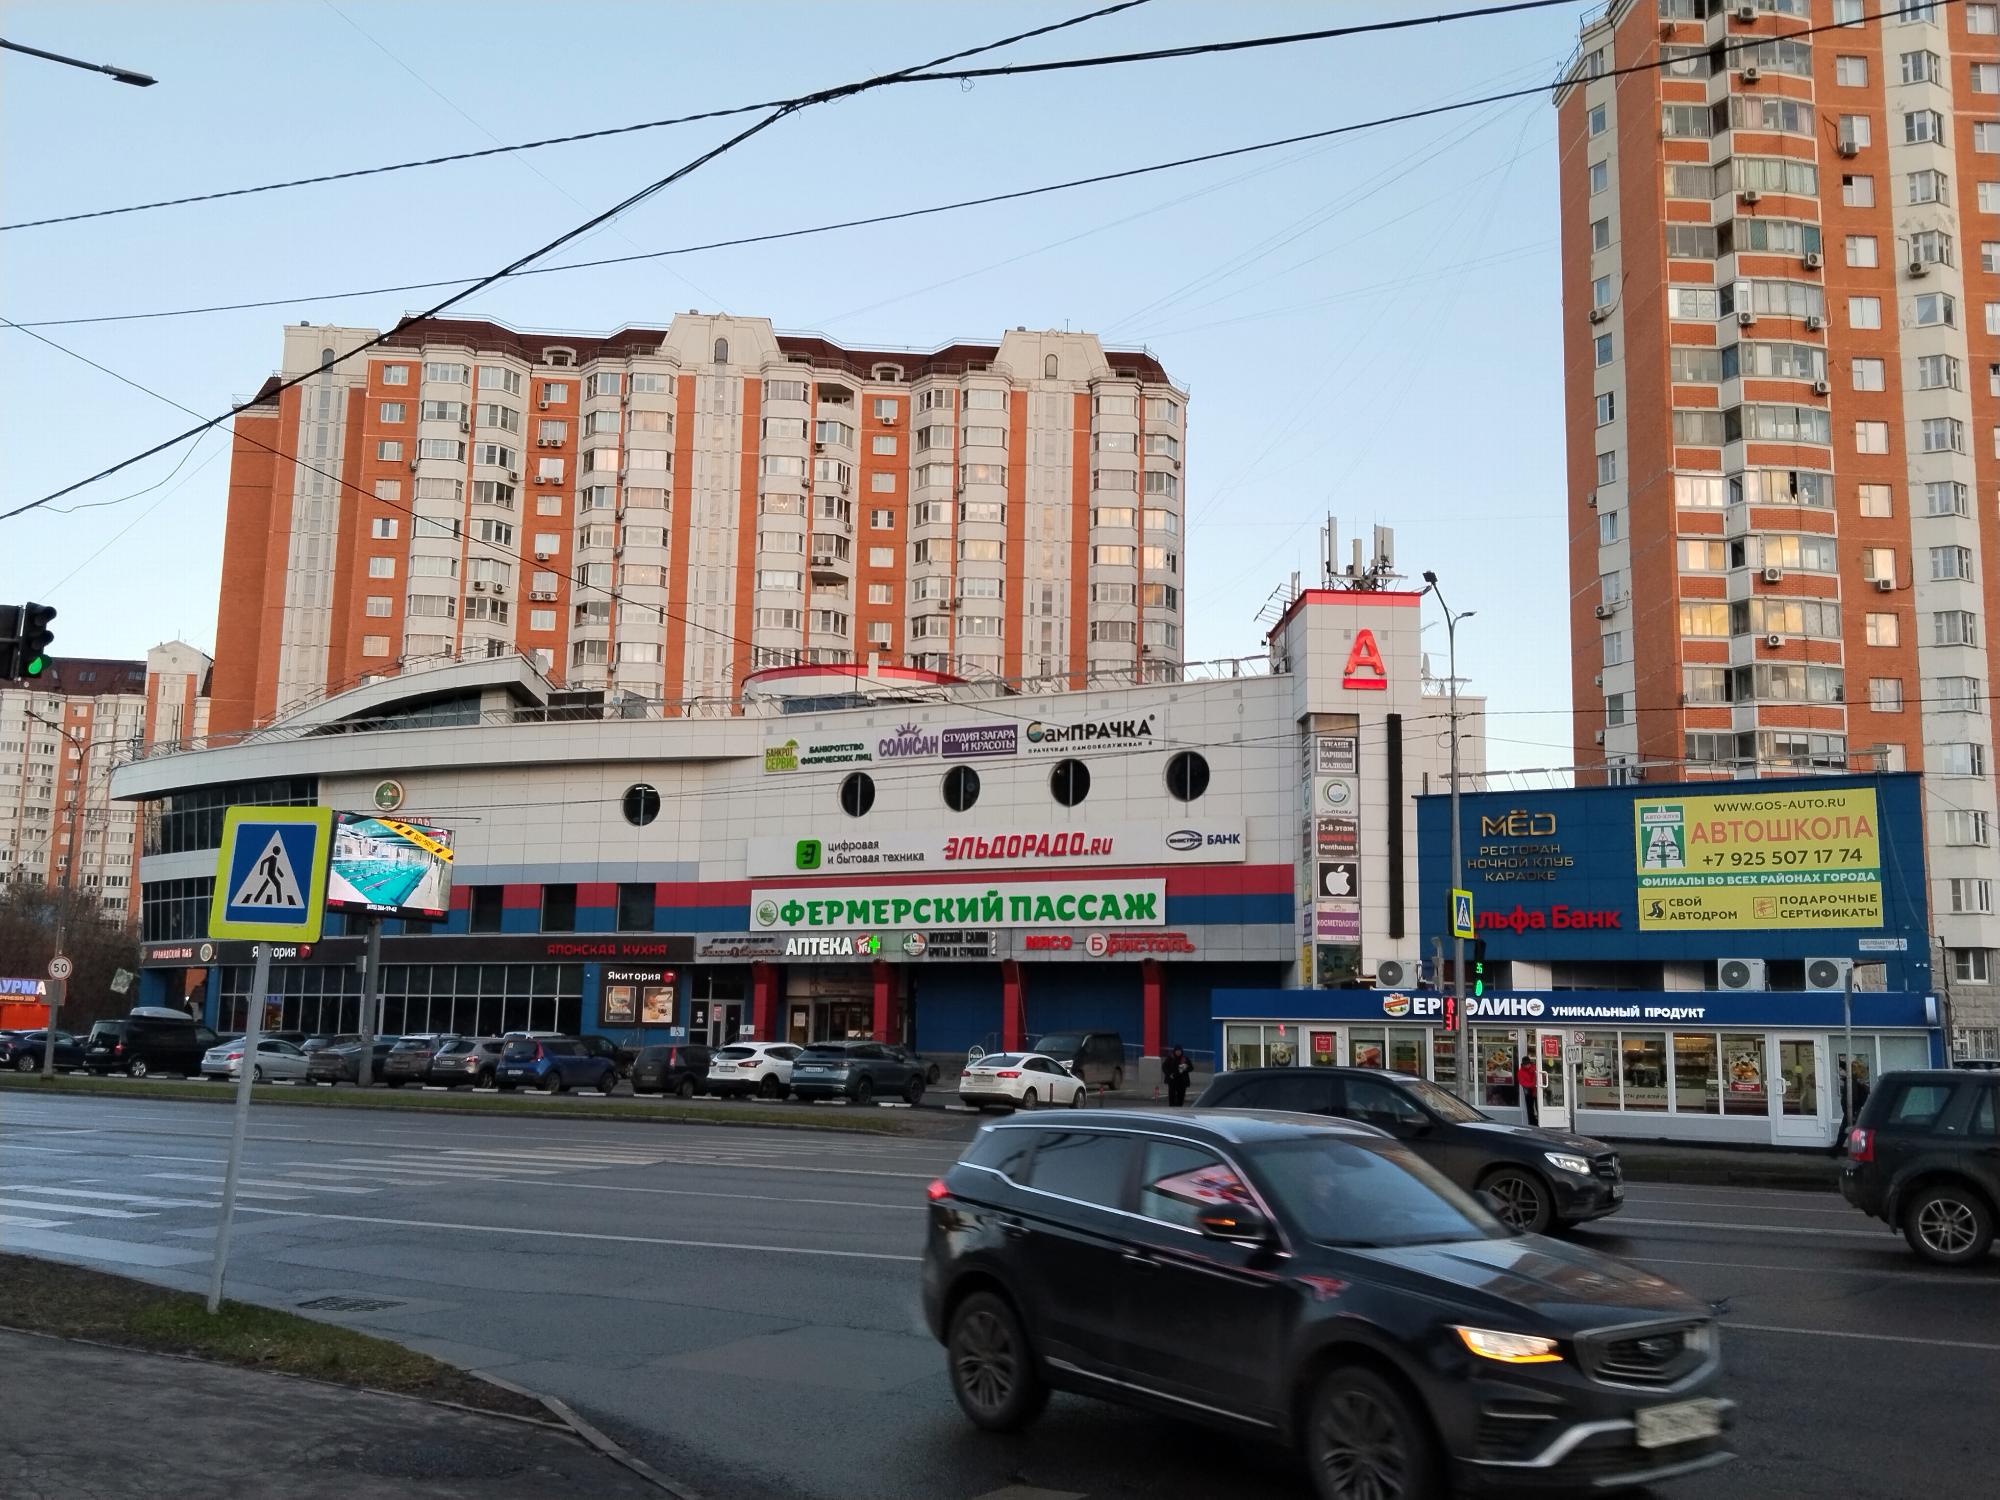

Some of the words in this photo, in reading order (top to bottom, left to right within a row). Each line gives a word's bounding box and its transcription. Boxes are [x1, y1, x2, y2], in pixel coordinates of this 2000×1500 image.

[943, 732, 979, 743] СТУДИЯ
[981, 729, 1016, 740] ЗАГАРА
[1027, 719, 1152, 743] СамПРАЧКА
[766, 747, 793, 757] БАНКРОТ
[809, 743, 864, 753] БАНКРОТСТВО
[879, 735, 939, 757] СОЛИСАН
[962, 743, 968, 752] И
[971, 740, 1016, 751] КРАСОТЫ
[766, 757, 798, 770] СЕРВИС
[801, 754, 853, 765] ФИЗИЧЕСКИХ
[855, 753, 872, 762] ЛИЦ
[1714, 798, 1846, 812] WWW.GOS-AUTO.RU
[1690, 815, 1873, 845] АВТОШКОЛА
[828, 839, 880, 852] цифровая
[1207, 833, 1241, 845] БАНК
[1480, 844, 1561, 856] РЕСТОРАН
[837, 852, 880, 865] бытовая
[882, 852, 925, 862] техника
[1467, 857, 1529, 869] НОЧНОЙ
[1533, 856, 1574, 867] КЛУБ
[1703, 853, 1725, 867] +7
[1731, 852, 1766, 866] 925
[1772, 850, 1809, 865] 507
[1814, 850, 1834, 864] 17
[1840, 848, 1863, 863] 74
[1485, 871, 1556, 882] КАРАОКЕ
[1642, 875, 1705, 887] ФИЛИАЛЫ
[1707, 875, 1724, 885] ВО
[1727, 874, 1758, 885] ВСЕХ
[1760, 871, 1819, 884] РАЙОНАХ
[1823, 870, 1876, 882] ГОРОДА
[1669, 896, 1702, 907] СВОЙ
[1779, 893, 1877, 905] ПОДАРОЧНЫЕ
[780, 889, 1003, 926] ФЕРМЕРСКИЙ
[1008, 893, 1157, 922] ПАССАЖ
[1780, 908, 1878, 919] СЕРТИФИКАТЫ
[1473, 904, 1545, 935] льфа
[1551, 905, 1621, 929] Банк
[1670, 910, 1738, 921] АВТОДРОМ
[252, 945, 297, 960] Ятория
[547, 943, 617, 956] ЯПОНСКАЯ
[622, 943, 668, 956] КУХНЯ
[785, 936, 853, 956] АПТЕКА
[53, 964, 68, 972] 50
[608, 971, 661, 981] Якитория
[1413, 997, 1545, 1017] ЕРОЛИНО
[1551, 1005, 1640, 1017] УНИКАЛЬНЫЙ
[1644, 1007, 1706, 1020] ПРОДУКТ
